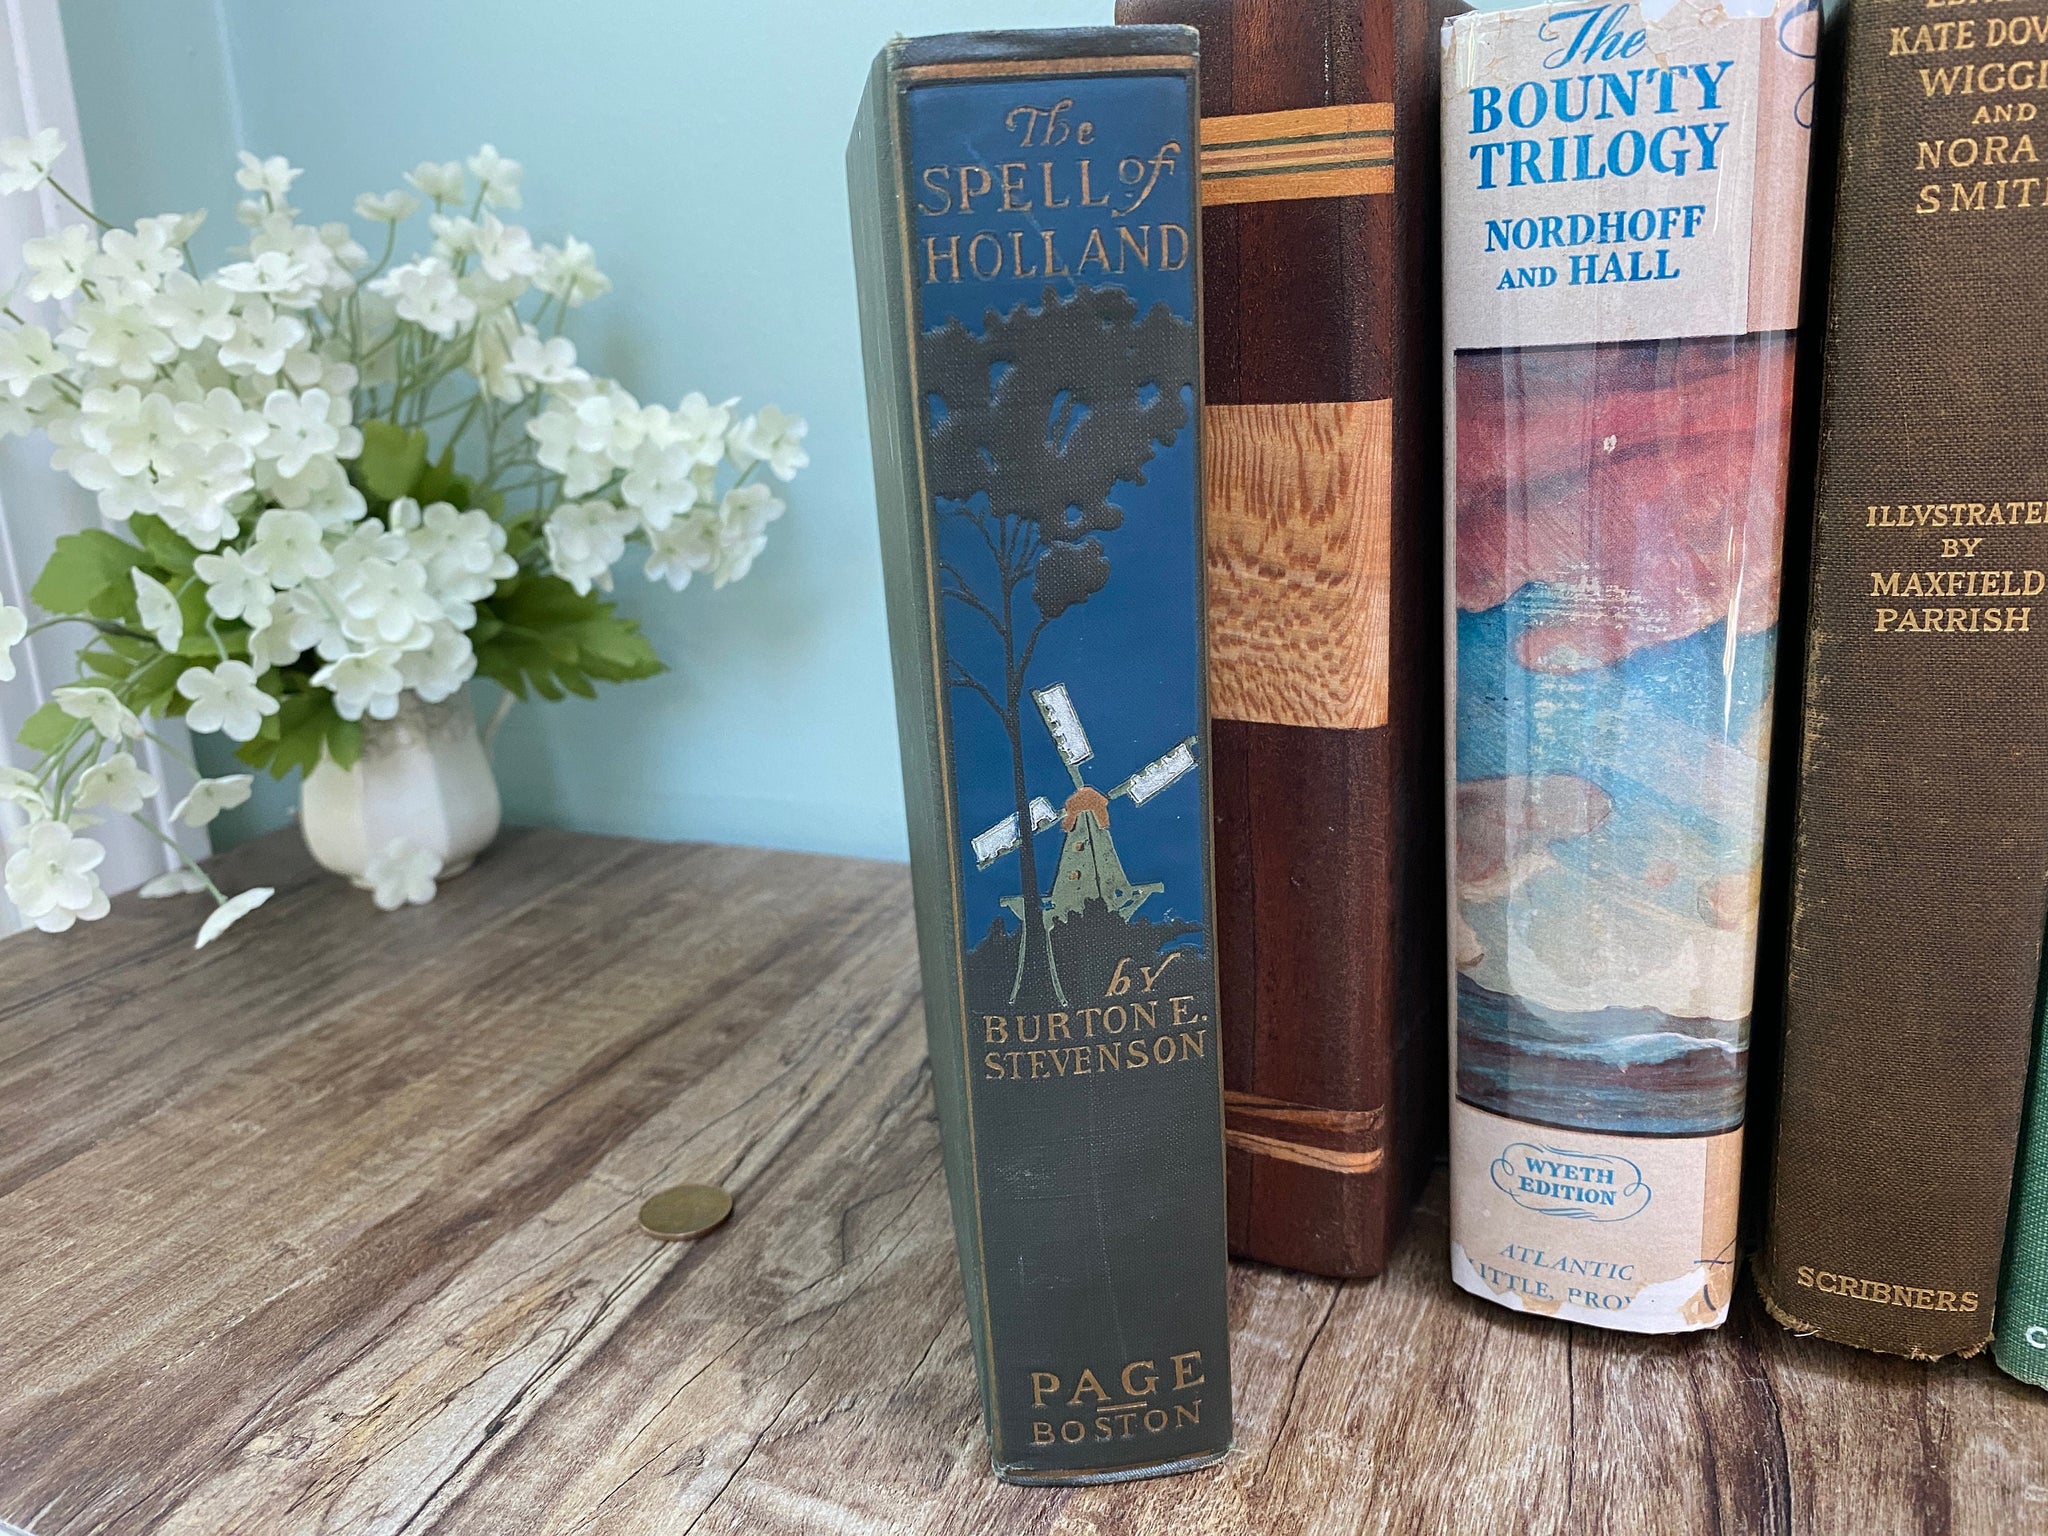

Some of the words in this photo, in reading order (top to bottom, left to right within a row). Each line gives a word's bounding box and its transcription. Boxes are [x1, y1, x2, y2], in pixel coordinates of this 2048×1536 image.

[1539, 2, 1647, 69] The
[1889, 19, 1976, 56] KATE
[1468, 60, 1735, 134] BOUNTY
[1972, 102, 2038, 124] AND
[1005, 97, 1095, 147] The
[1469, 122, 1730, 190] TRILOGY
[1915, 134, 2039, 170] NORA
[918, 157, 1111, 216] SPELL
[1111, 140, 1182, 218] of
[1484, 205, 1706, 252] NORDHOFF
[922, 222, 1190, 285] HOLLAND
[1496, 266, 1558, 290] AND
[1569, 249, 1681, 286] HALL
[1866, 500, 2048, 527] ILLVSTRATE
[1941, 538, 1984, 557] BY
[1870, 570, 2047, 597] MAXFIELD
[1874, 607, 2031, 632] PARRISH
[983, 1000, 1158, 1043] BURTON
[1169, 995, 1208, 1026] E.
[984, 1029, 1206, 1080] STEVENSON
[1517, 1175, 1617, 1206] EDITION
[1523, 1156, 1615, 1185] WYETH
[1468, 1258, 1554, 1301] ITTLE,
[1499, 1243, 1635, 1281] ATLANTIC
[1797, 1265, 1979, 1312] SCRIBNERS
[1031, 1350, 1206, 1408] PAGE
[1029, 1400, 1203, 1446] BOSTON
